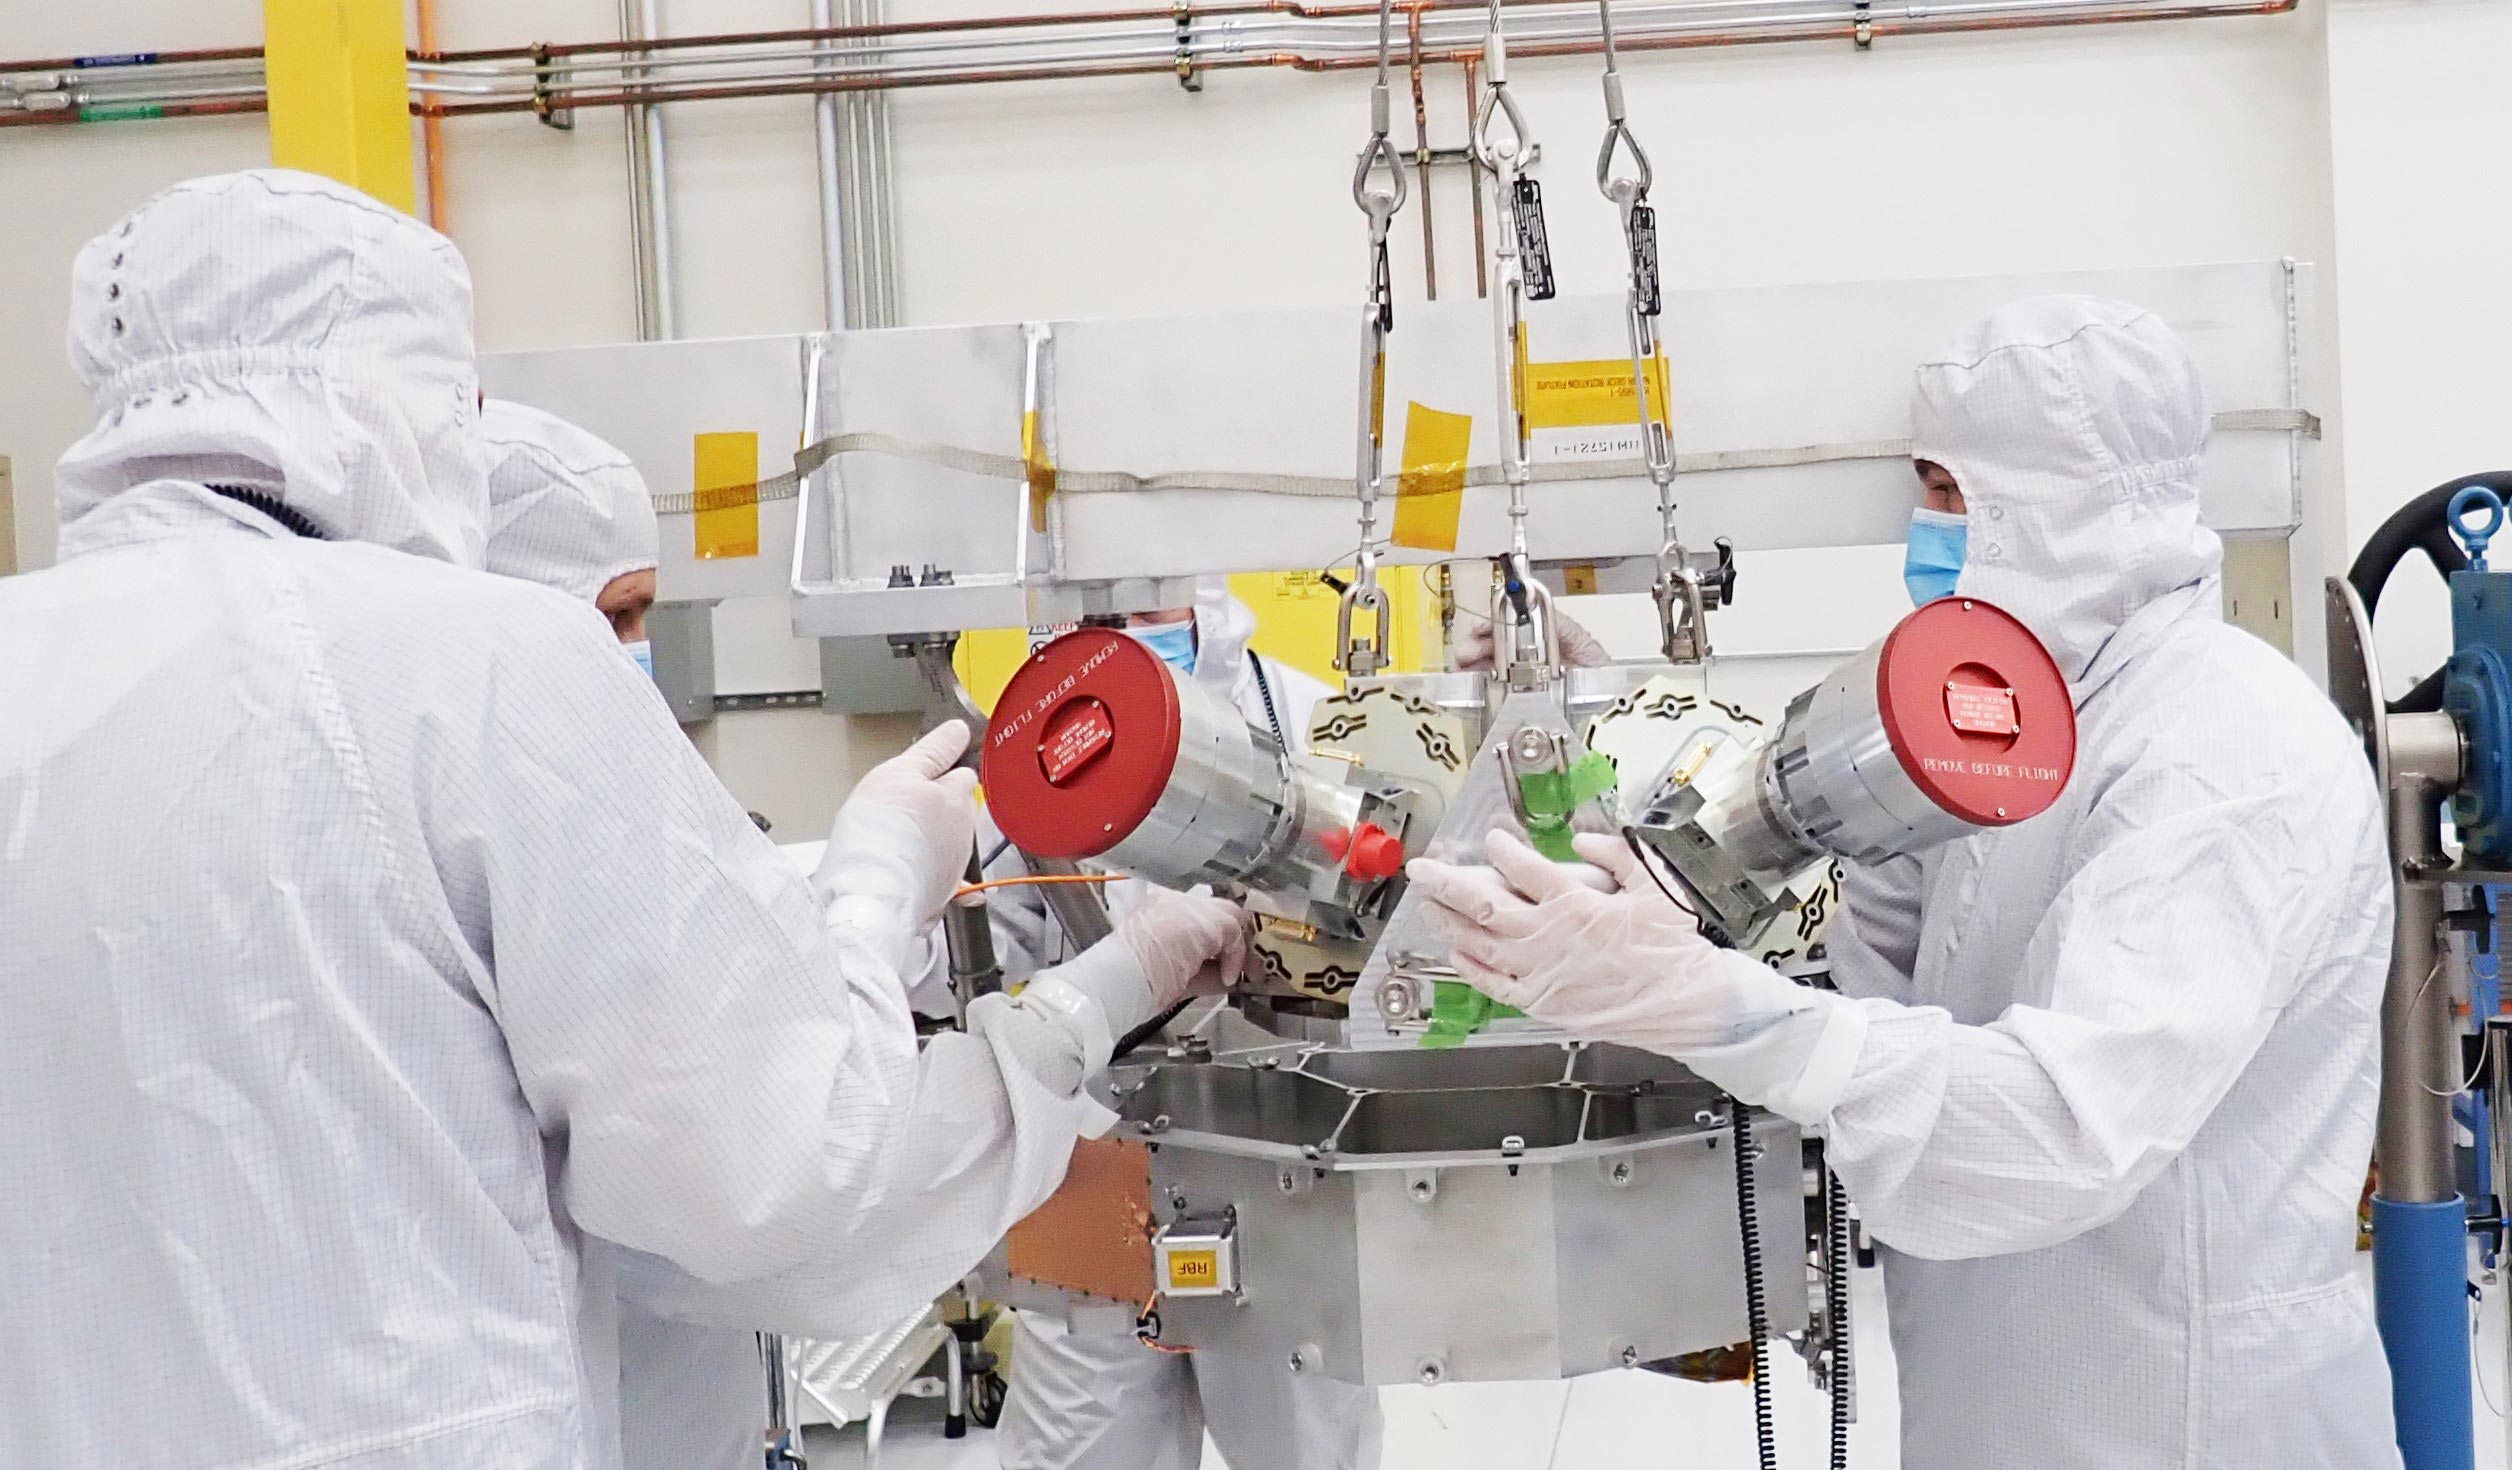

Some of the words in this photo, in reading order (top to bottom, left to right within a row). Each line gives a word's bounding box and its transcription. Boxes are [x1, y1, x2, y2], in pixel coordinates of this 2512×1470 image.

[1078, 640, 1119, 678] REMOVE
[1035, 675, 1075, 712] BEFORE
[995, 709, 1033, 747] FLIGHT
[1923, 757, 1965, 773] REMOVE
[1971, 762, 2012, 777] BEFORE
[2018, 766, 2059, 781] FLIGHT
[1177, 1261, 1207, 1274] RBF
